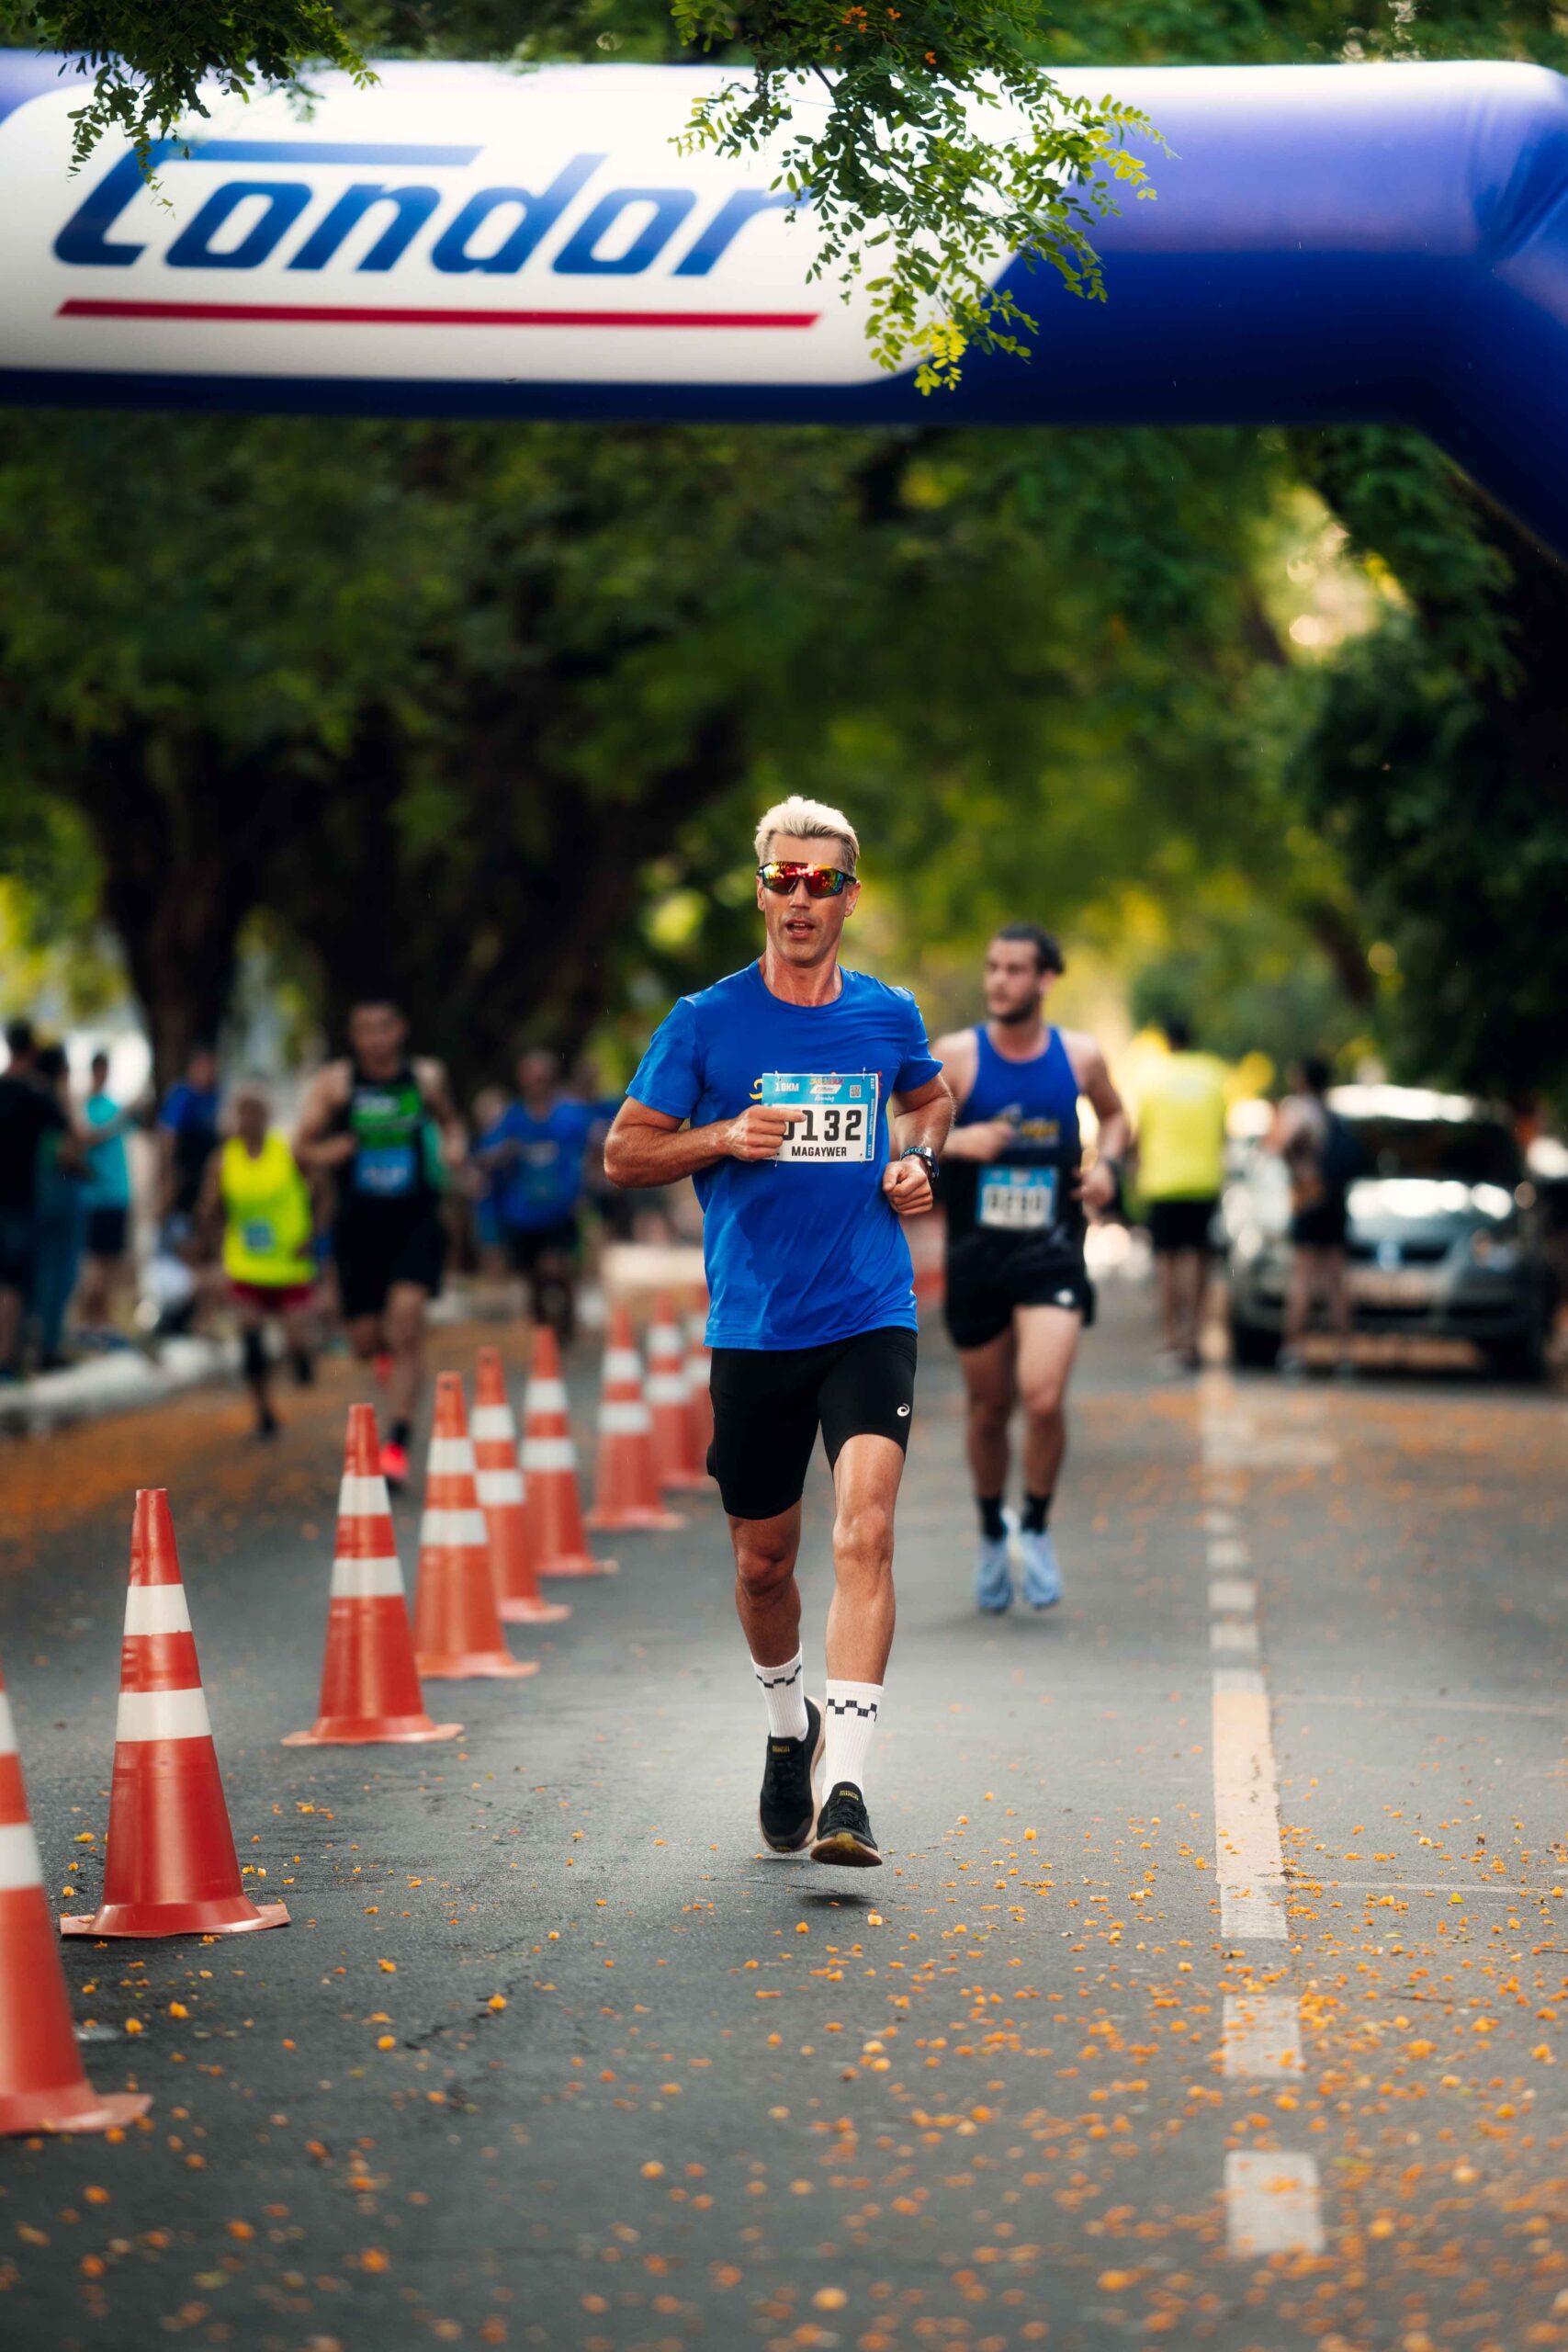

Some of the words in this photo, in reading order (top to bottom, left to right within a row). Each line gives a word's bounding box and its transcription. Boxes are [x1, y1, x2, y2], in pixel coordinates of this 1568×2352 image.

[52, 139, 811, 277] Condor
[775, 1082, 799, 1092] 10KM
[791, 1146, 847, 1157] MAGAYWER
